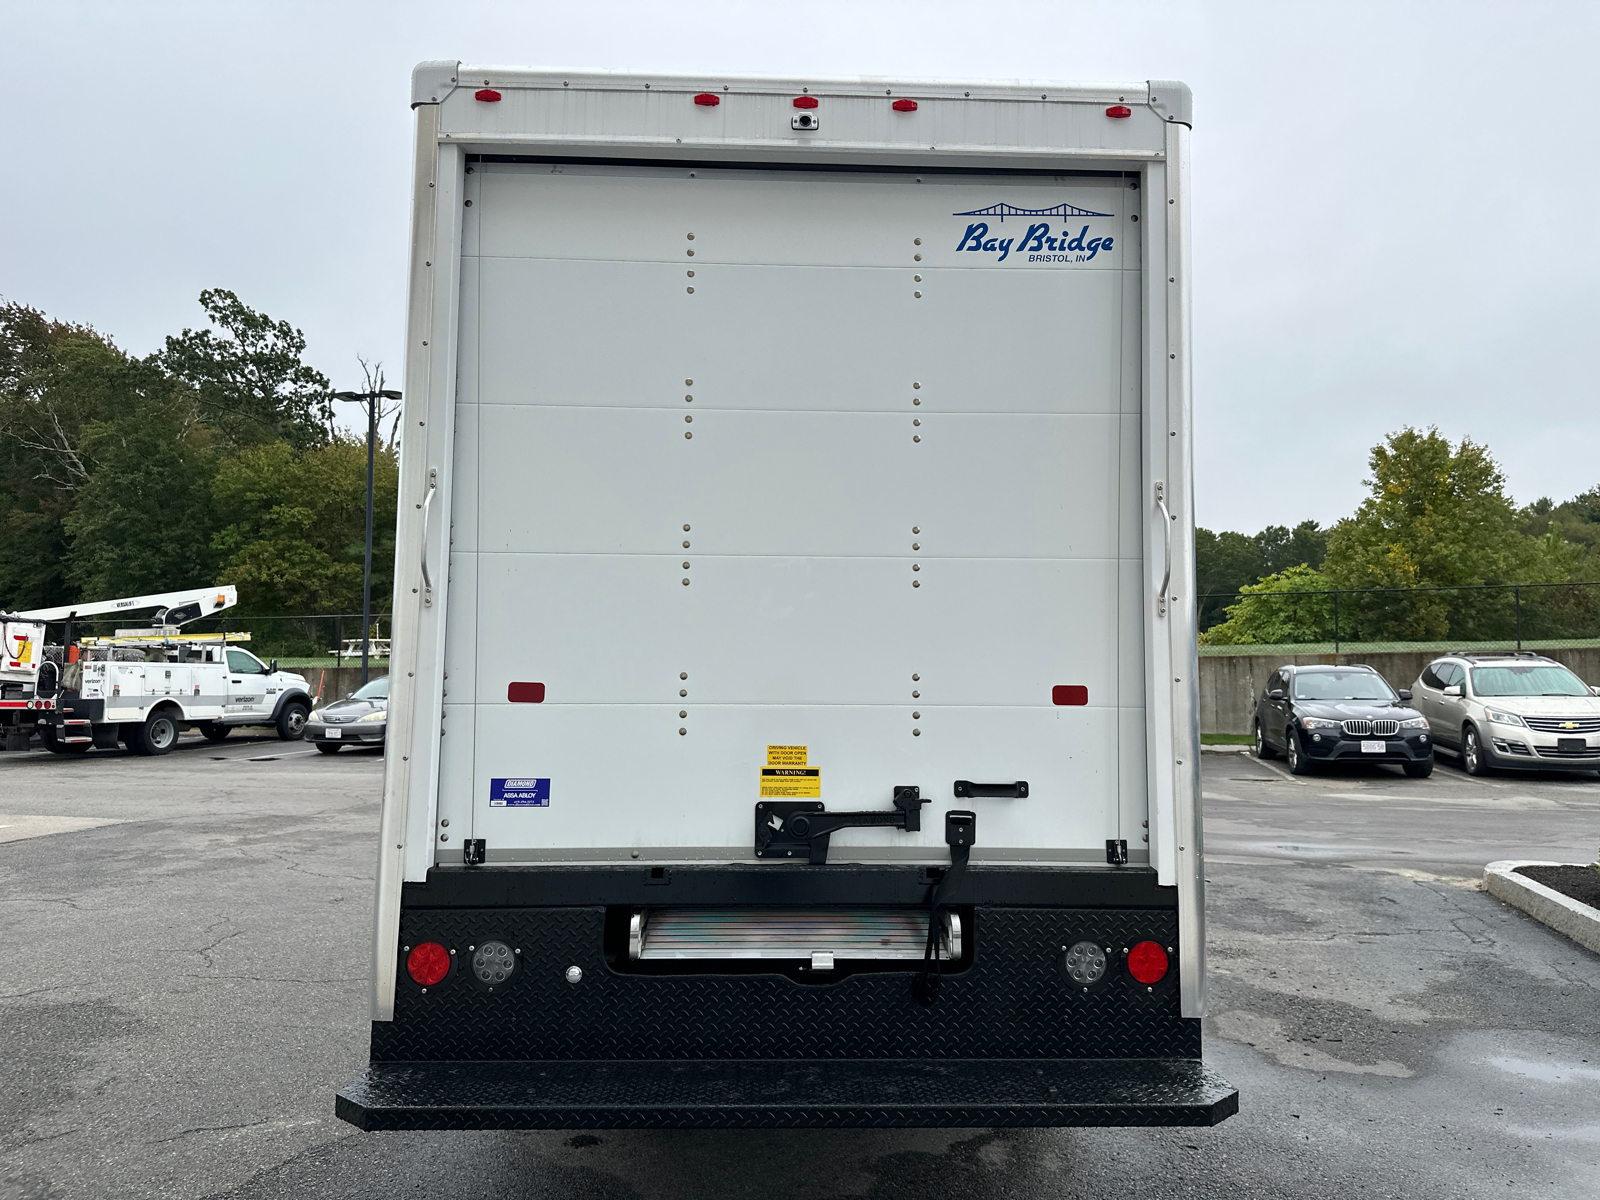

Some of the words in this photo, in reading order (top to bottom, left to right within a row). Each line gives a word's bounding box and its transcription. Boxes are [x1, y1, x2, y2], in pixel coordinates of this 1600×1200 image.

[955, 222, 1015, 262] Bay
[1015, 222, 1114, 262] Bridge
[1028, 254, 1073, 264] BRISTOL,
[1075, 254, 1086, 263] IN
[851, 815, 895, 824] DIAMOND
